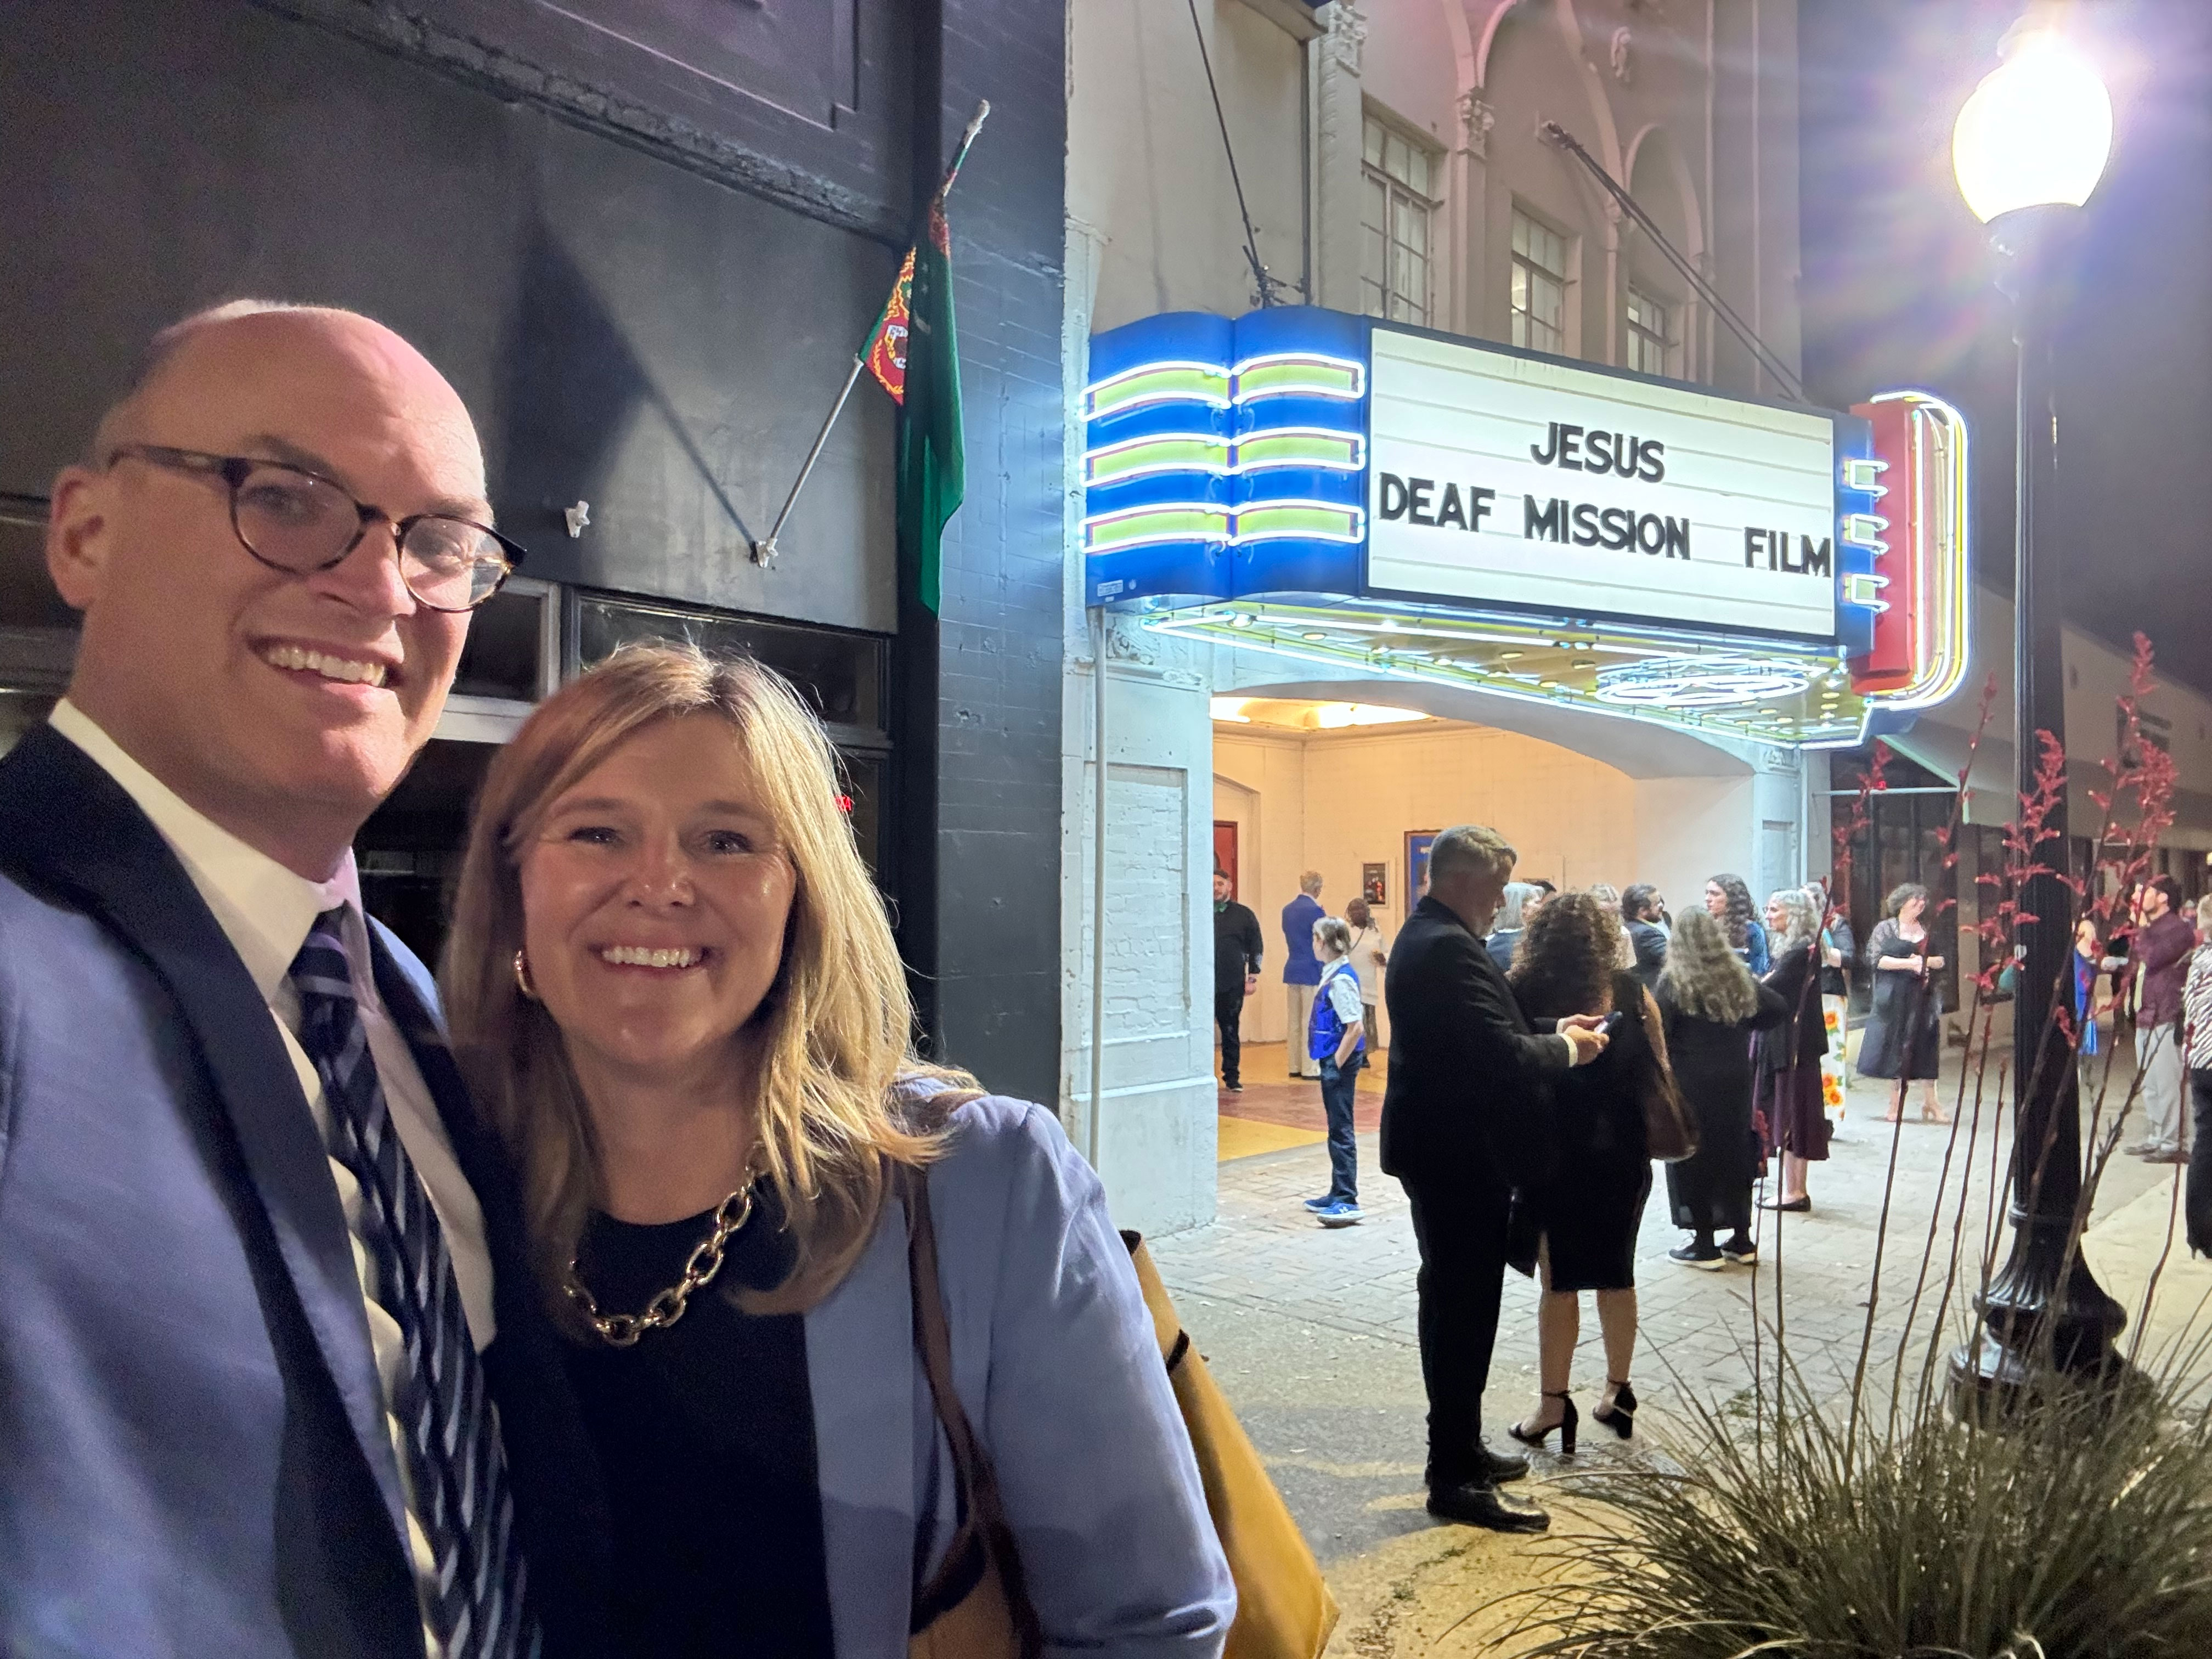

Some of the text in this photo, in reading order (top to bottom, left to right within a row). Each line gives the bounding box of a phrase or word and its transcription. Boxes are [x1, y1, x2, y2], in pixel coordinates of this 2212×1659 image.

[1531, 422, 1665, 483] JESUS
[1379, 472, 1831, 578] DEAF MISSION FILM
